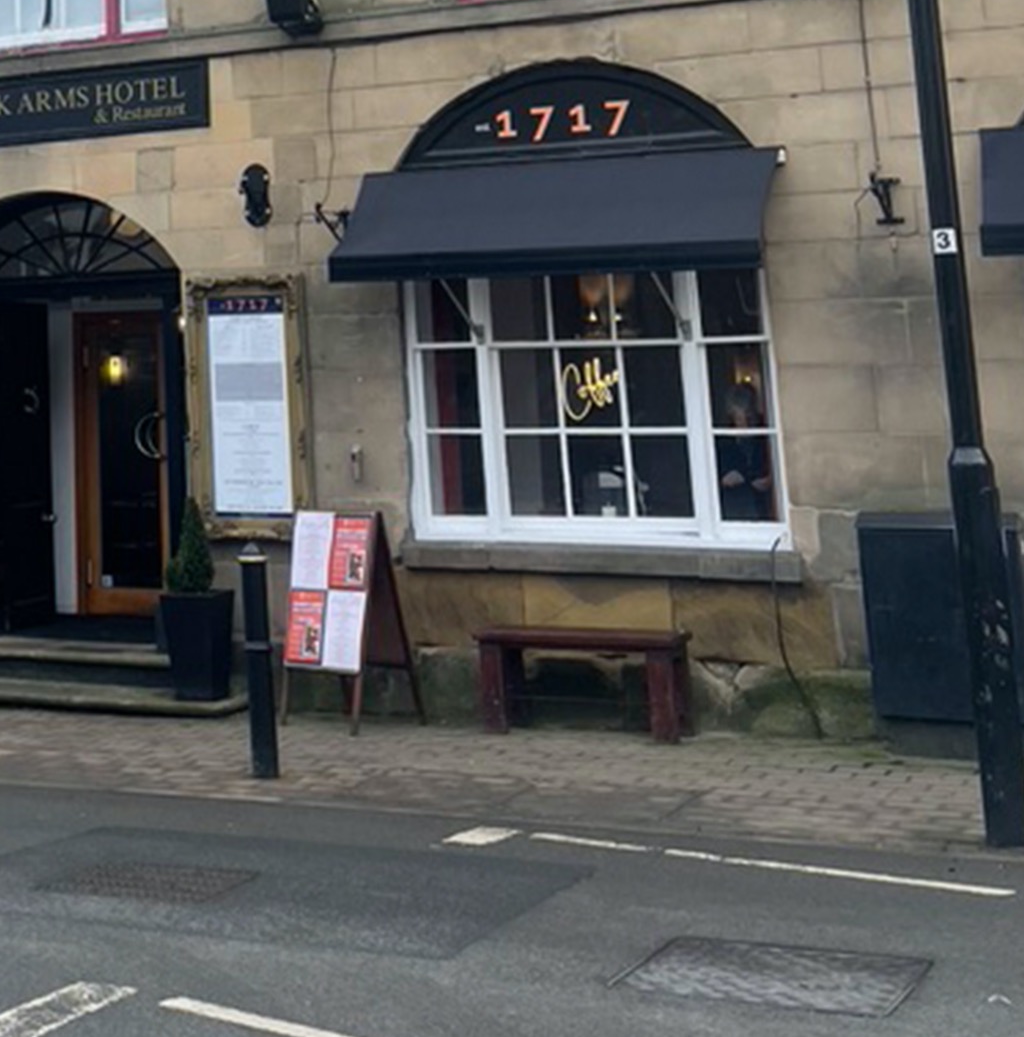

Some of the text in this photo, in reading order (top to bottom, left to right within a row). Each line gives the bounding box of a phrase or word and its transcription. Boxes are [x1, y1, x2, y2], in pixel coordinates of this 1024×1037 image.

[17, 85, 90, 116] ARMS
[95, 75, 186, 106] HOTEL
[92, 102, 186, 124] & Restaurant
[494, 99, 630, 142] 1717
[937, 232, 951, 250] 3
[225, 298, 268, 312] 1717
